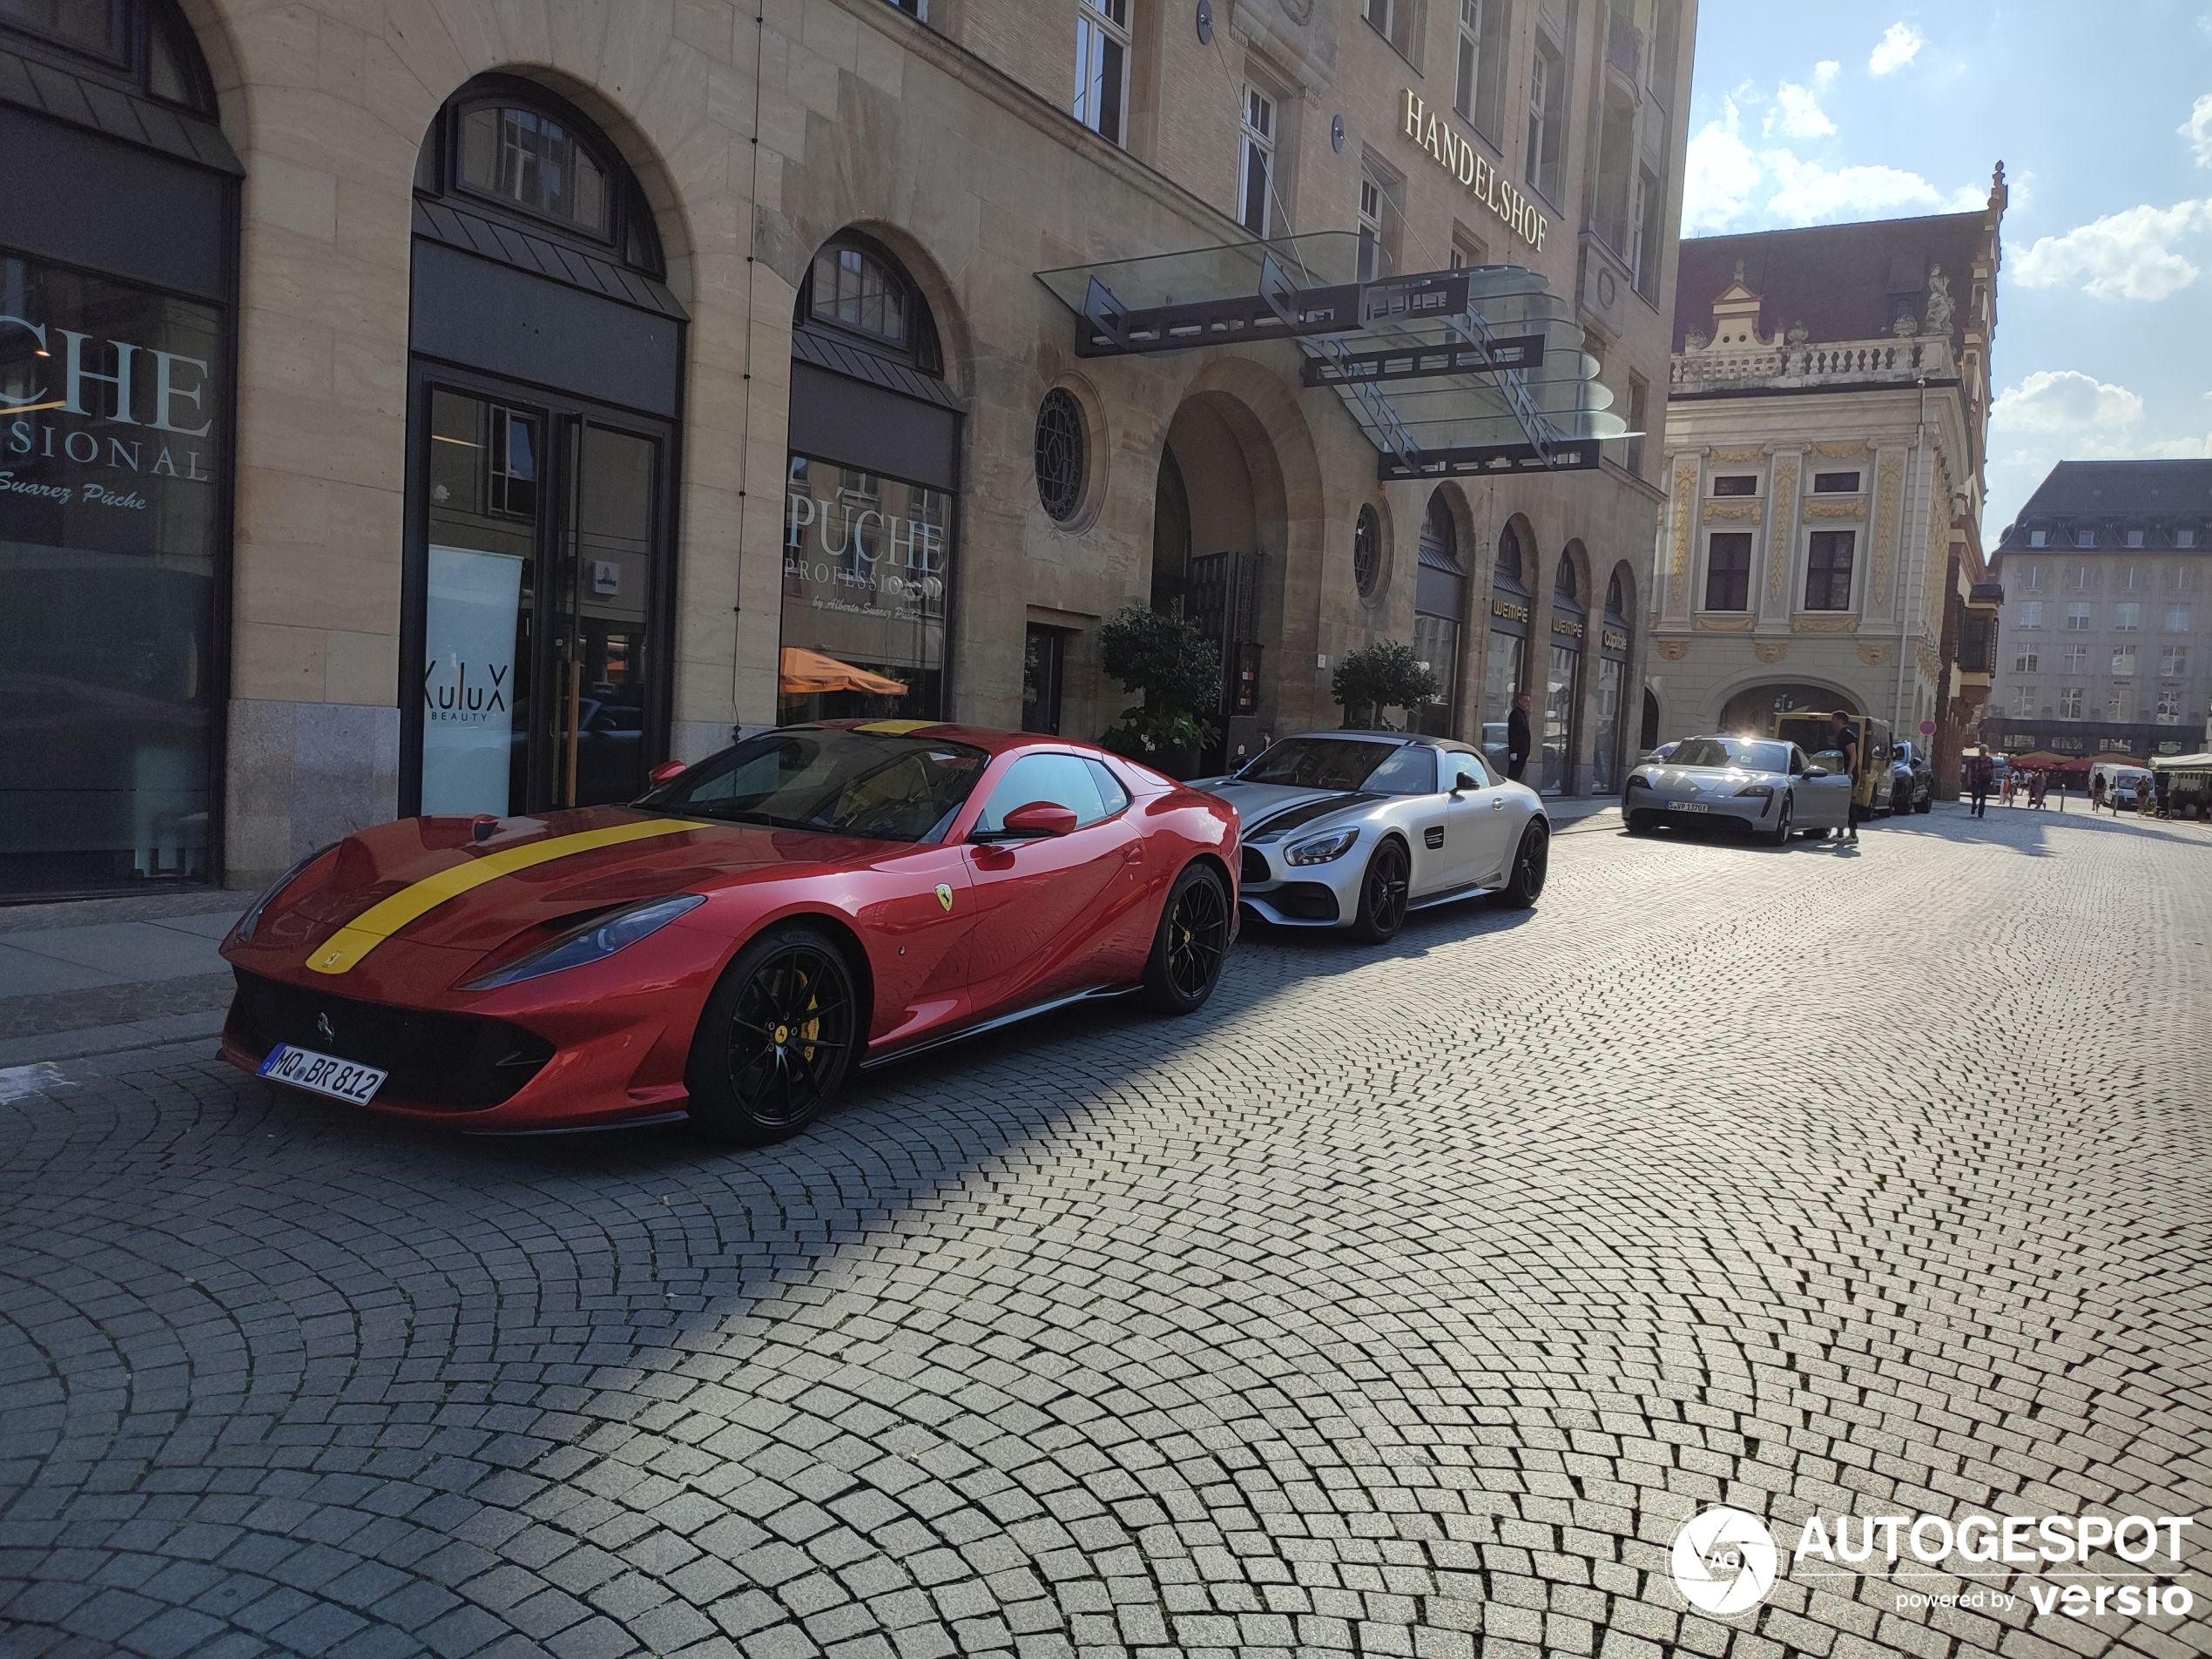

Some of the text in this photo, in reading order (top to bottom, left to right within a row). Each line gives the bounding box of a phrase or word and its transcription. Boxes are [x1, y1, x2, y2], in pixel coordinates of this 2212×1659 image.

[1404, 87, 1548, 253] HANDELSHOF
[0, 471, 72, 504] Suarez
[785, 557, 942, 601] PROFESSIONAL
[812, 595, 823, 609] by
[826, 597, 859, 612] Alberto
[1493, 599, 1528, 624] WEMPE
[1553, 617, 1582, 638] WEMPE
[431, 711, 488, 722] BEAUTY
[269, 1049, 380, 1099] MQ BR 812
